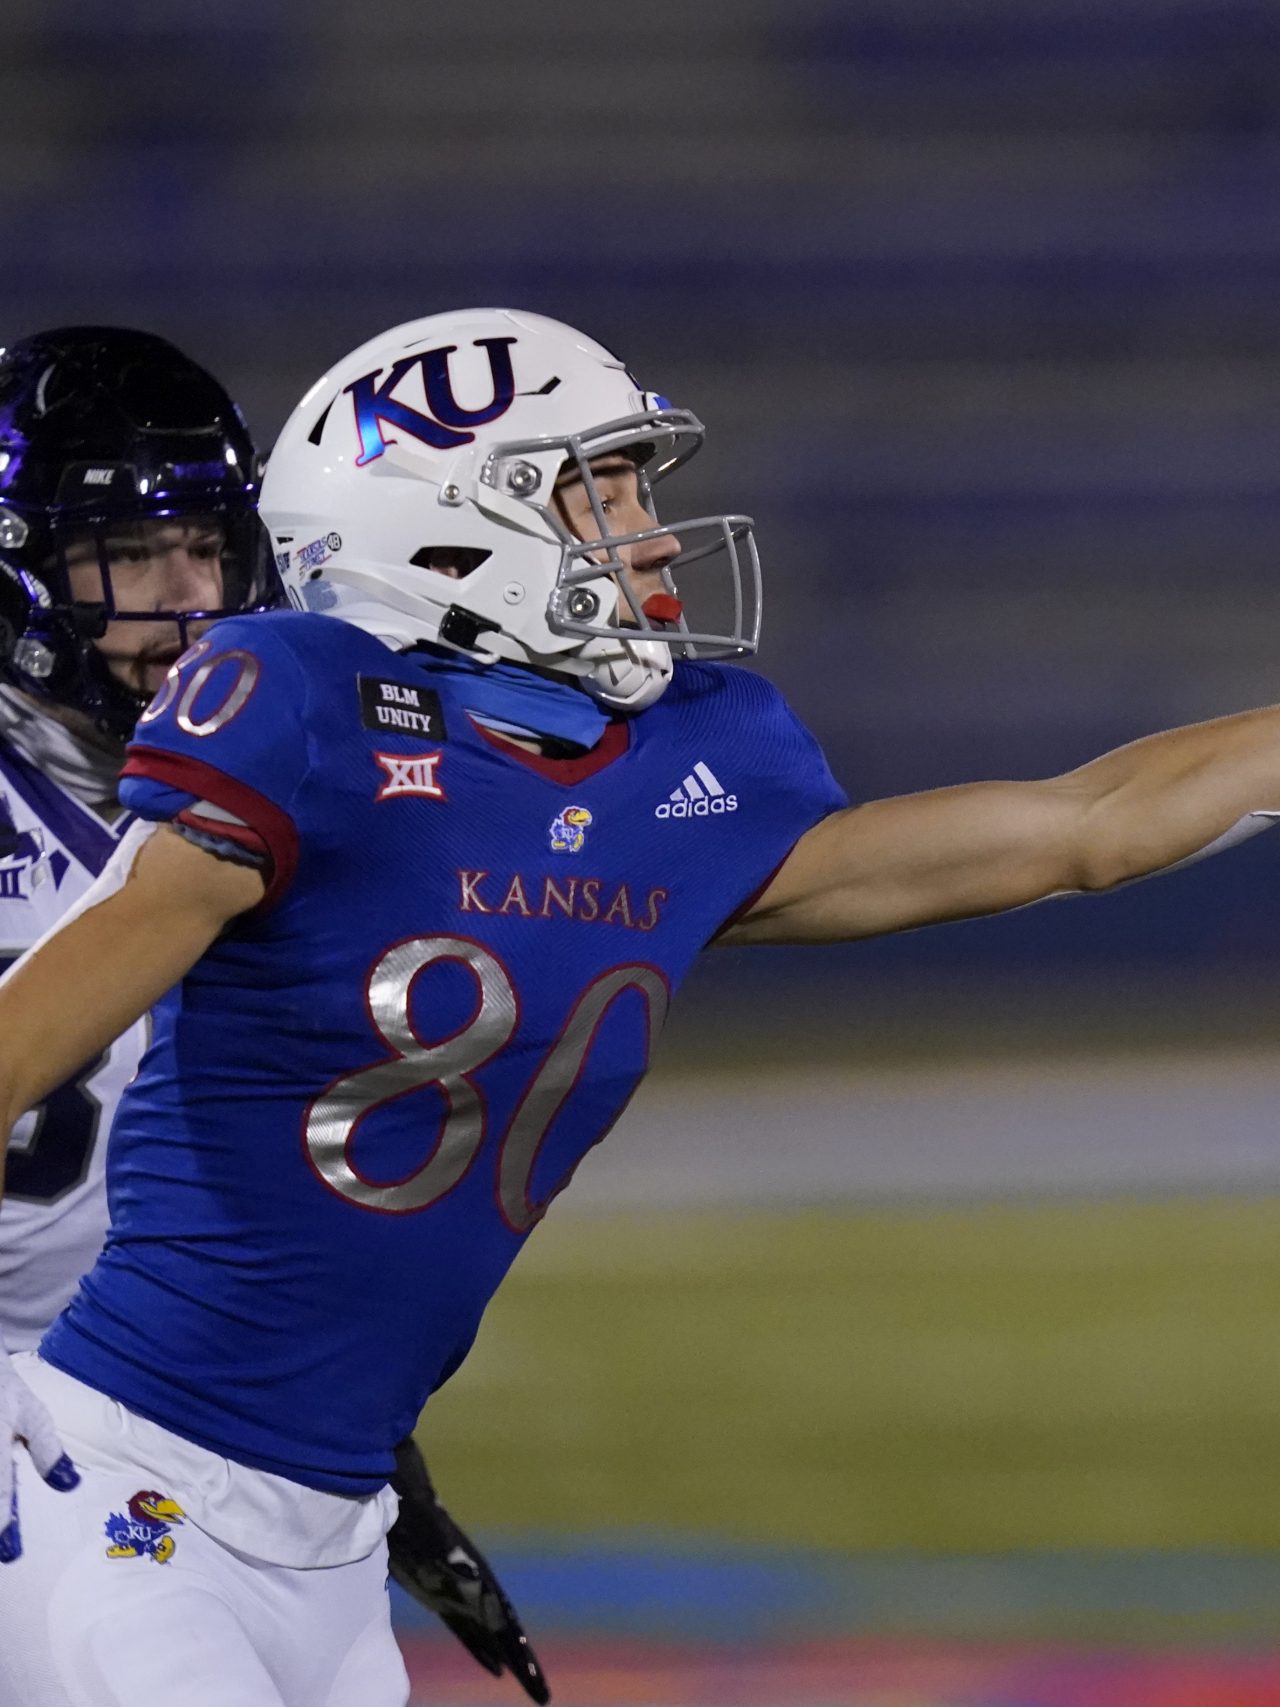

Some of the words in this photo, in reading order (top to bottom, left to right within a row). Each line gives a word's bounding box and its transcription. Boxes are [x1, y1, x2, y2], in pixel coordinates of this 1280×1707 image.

[342, 336, 519, 467] KU
[83, 468, 115, 485] NIKE
[379, 683, 420, 707] BLM
[375, 706, 431, 732] UNITY
[378, 755, 442, 796] XII
[655, 794, 738, 820] adidas
[456, 868, 668, 931] KANSAS
[301, 932, 672, 1234] 80
[127, 1525, 153, 1542] KU
